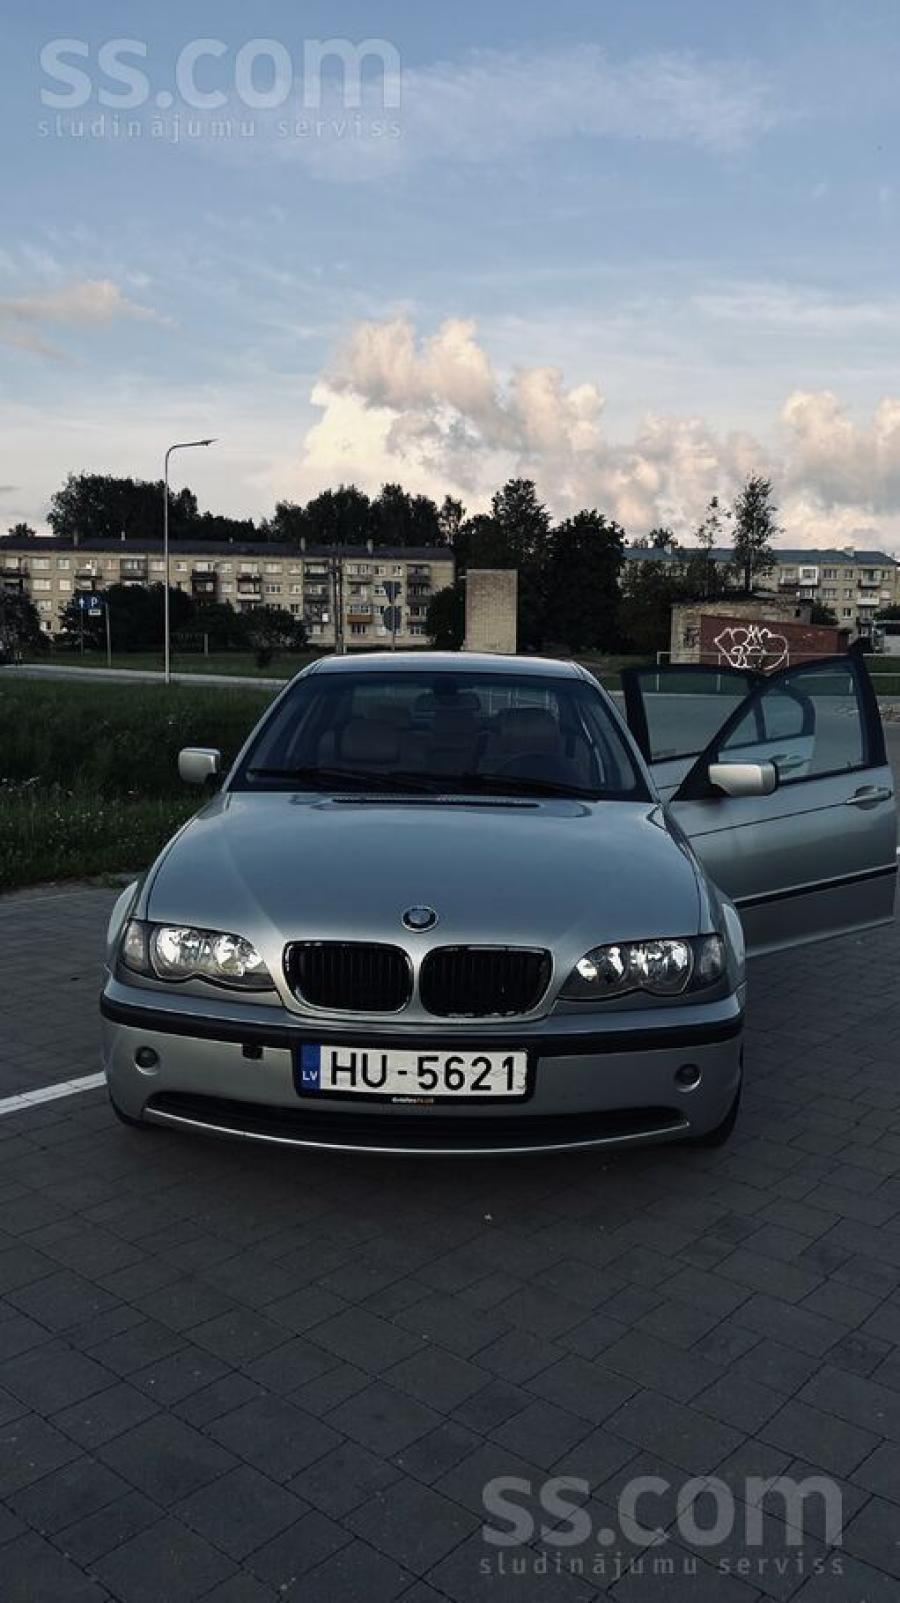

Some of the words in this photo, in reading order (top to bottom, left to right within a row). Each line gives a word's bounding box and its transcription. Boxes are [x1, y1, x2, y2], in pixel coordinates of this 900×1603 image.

[91, 597, 98, 606] P
[302, 1071, 318, 1081] LV
[331, 1051, 514, 1091] HU-5621
